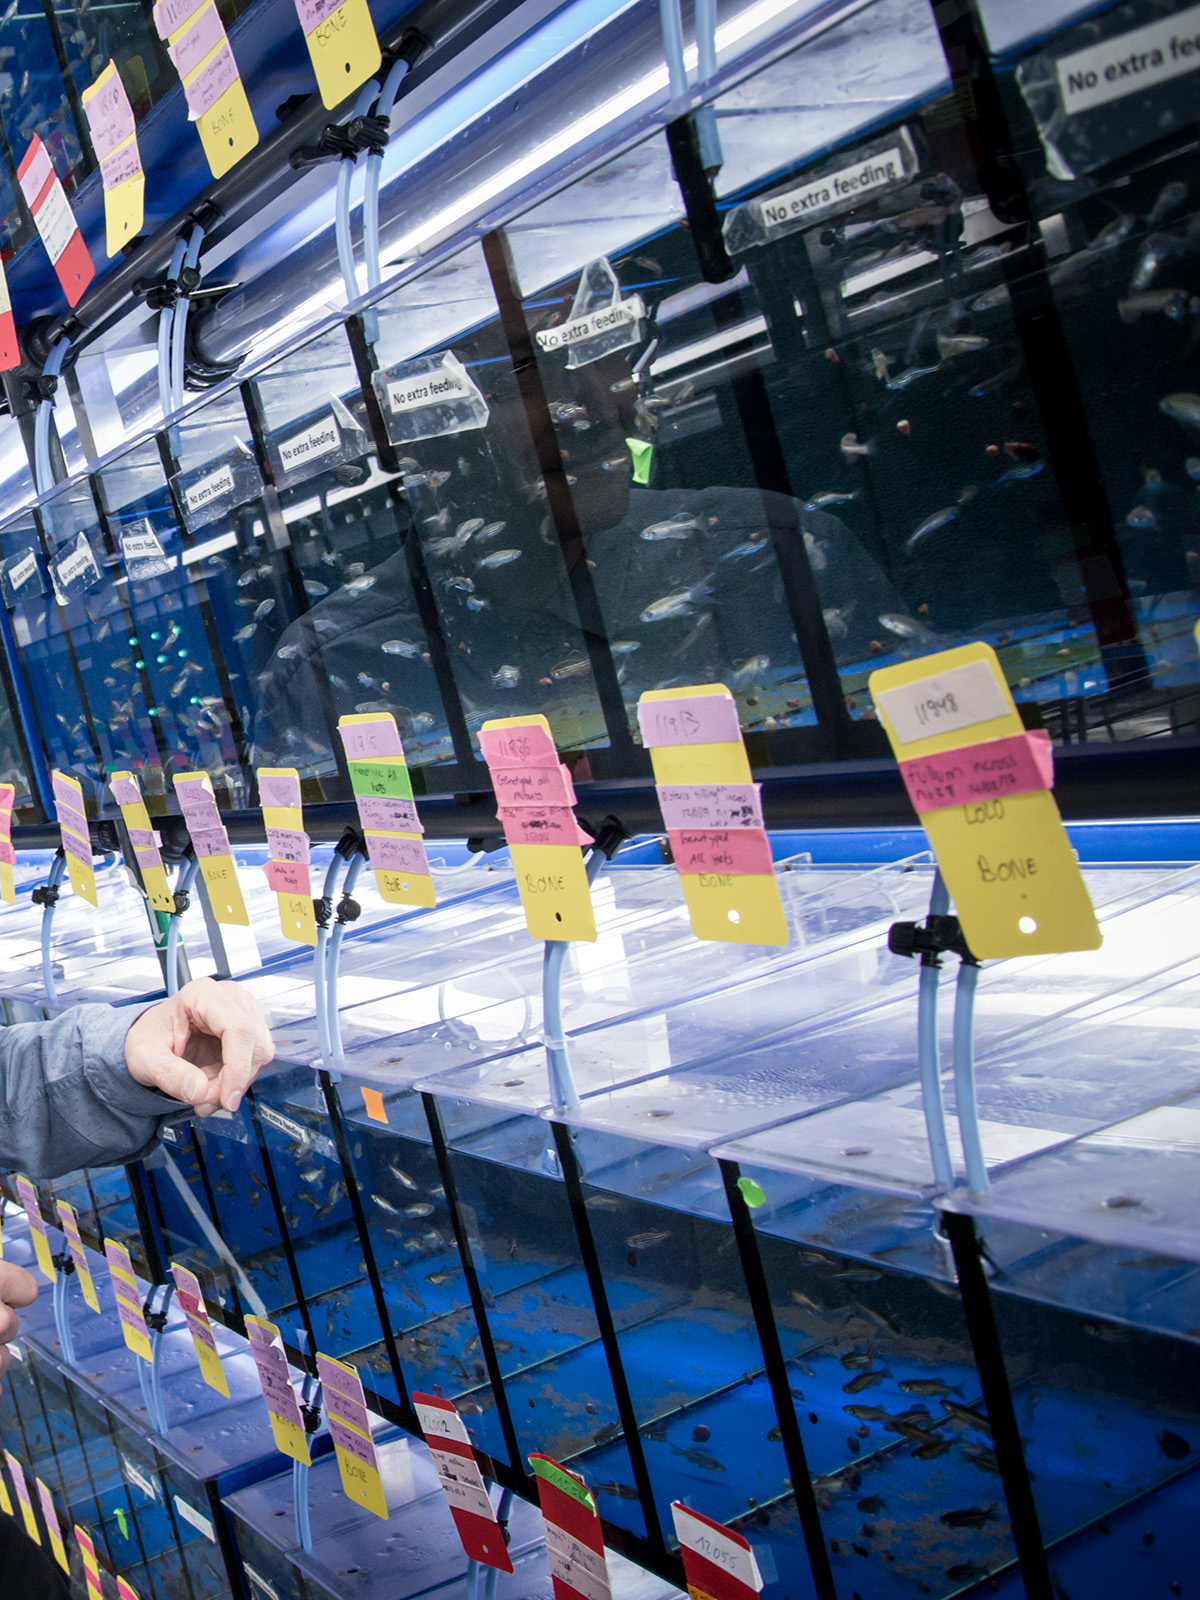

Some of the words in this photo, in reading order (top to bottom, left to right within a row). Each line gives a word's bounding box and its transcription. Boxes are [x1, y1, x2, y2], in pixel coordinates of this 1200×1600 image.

[1067, 70, 1098, 94] No
[1104, 48, 1164, 82] extra
[765, 206, 787, 223] No
[791, 188, 830, 214] extra
[834, 161, 896, 198] feeding
[562, 323, 589, 342] extra
[393, 392, 406, 405] No
[407, 385, 428, 401] extra
[282, 449, 292, 460] No
[293, 442, 309, 456] extra
[309, 429, 335, 449] feeding
[189, 494, 198, 503] No
[199, 488, 211, 501] extra
[211, 475, 232, 496] feeding
[132, 542, 144, 550] extra
[914, 692, 959, 726] 11948
[525, 873, 565, 894] BONE
[977, 854, 1038, 884] BONE
[269, 1112, 283, 1126] extra
[695, 1536, 739, 1569] 12055
